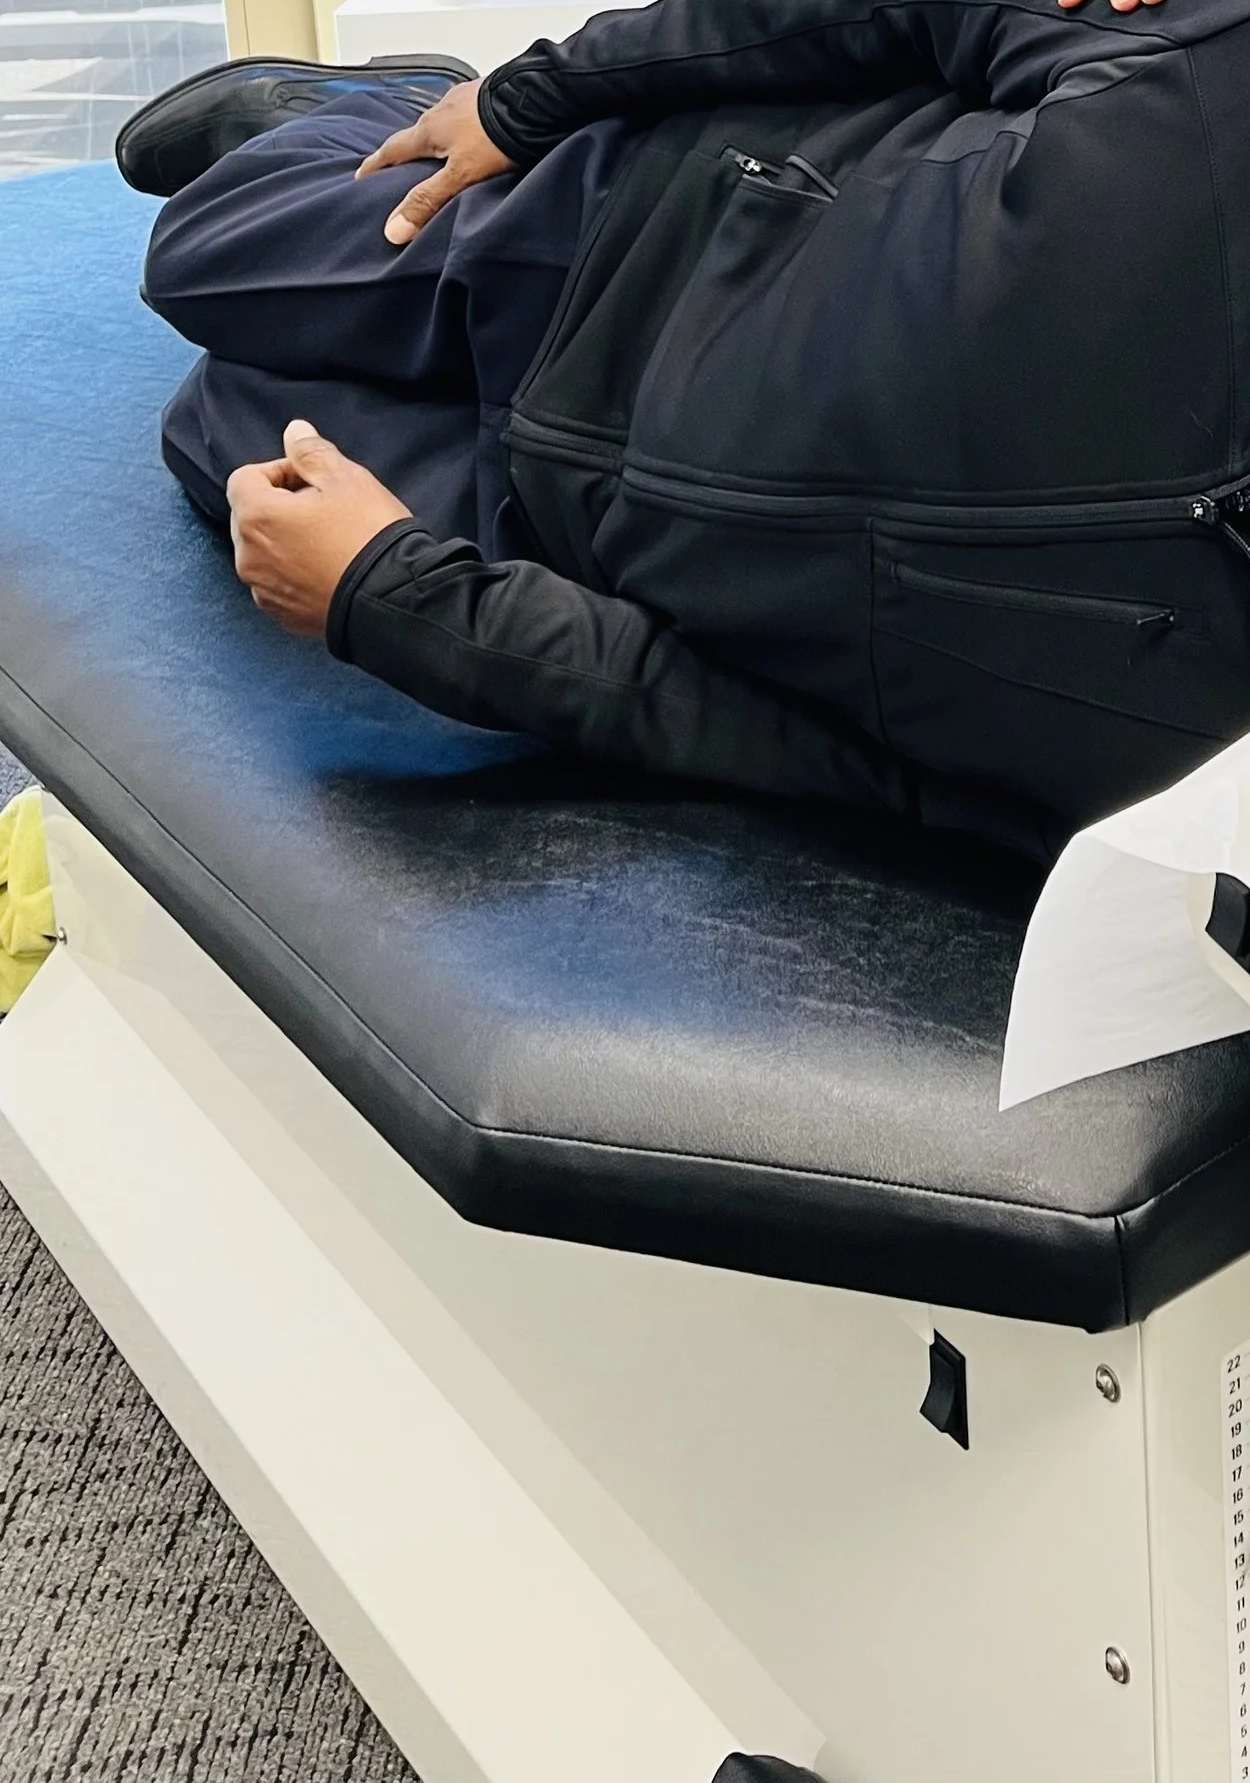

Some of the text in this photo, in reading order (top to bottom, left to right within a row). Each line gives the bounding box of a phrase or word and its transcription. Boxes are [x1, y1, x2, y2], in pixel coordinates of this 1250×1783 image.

[1227, 1354, 1241, 1373] 22
[1229, 1376, 1241, 1395] 21
[1228, 1398, 1243, 1418] 20
[1231, 1421, 1242, 1438] 19
[1231, 1443, 1242, 1460] 18
[1232, 1465, 1242, 1482] 17
[1233, 1487, 1243, 1504] 16
[1233, 1509, 1244, 1526] 15
[1234, 1531, 1244, 1548] 14
[1235, 1553, 1245, 1570] 13
[1235, 1574, 1246, 1591] 12
[1237, 1596, 1245, 1612] 11
[1236, 1617, 1247, 1634] 10
[1238, 1640, 1245, 1654] 9
[1239, 1661, 1246, 1675] 8
[1240, 1681, 1246, 1696] 7
[1240, 1703, 1247, 1718] 6
[1240, 1724, 1247, 1738] 5
[1241, 1745, 1248, 1758] 4
[1242, 1766, 1249, 1780] 3
